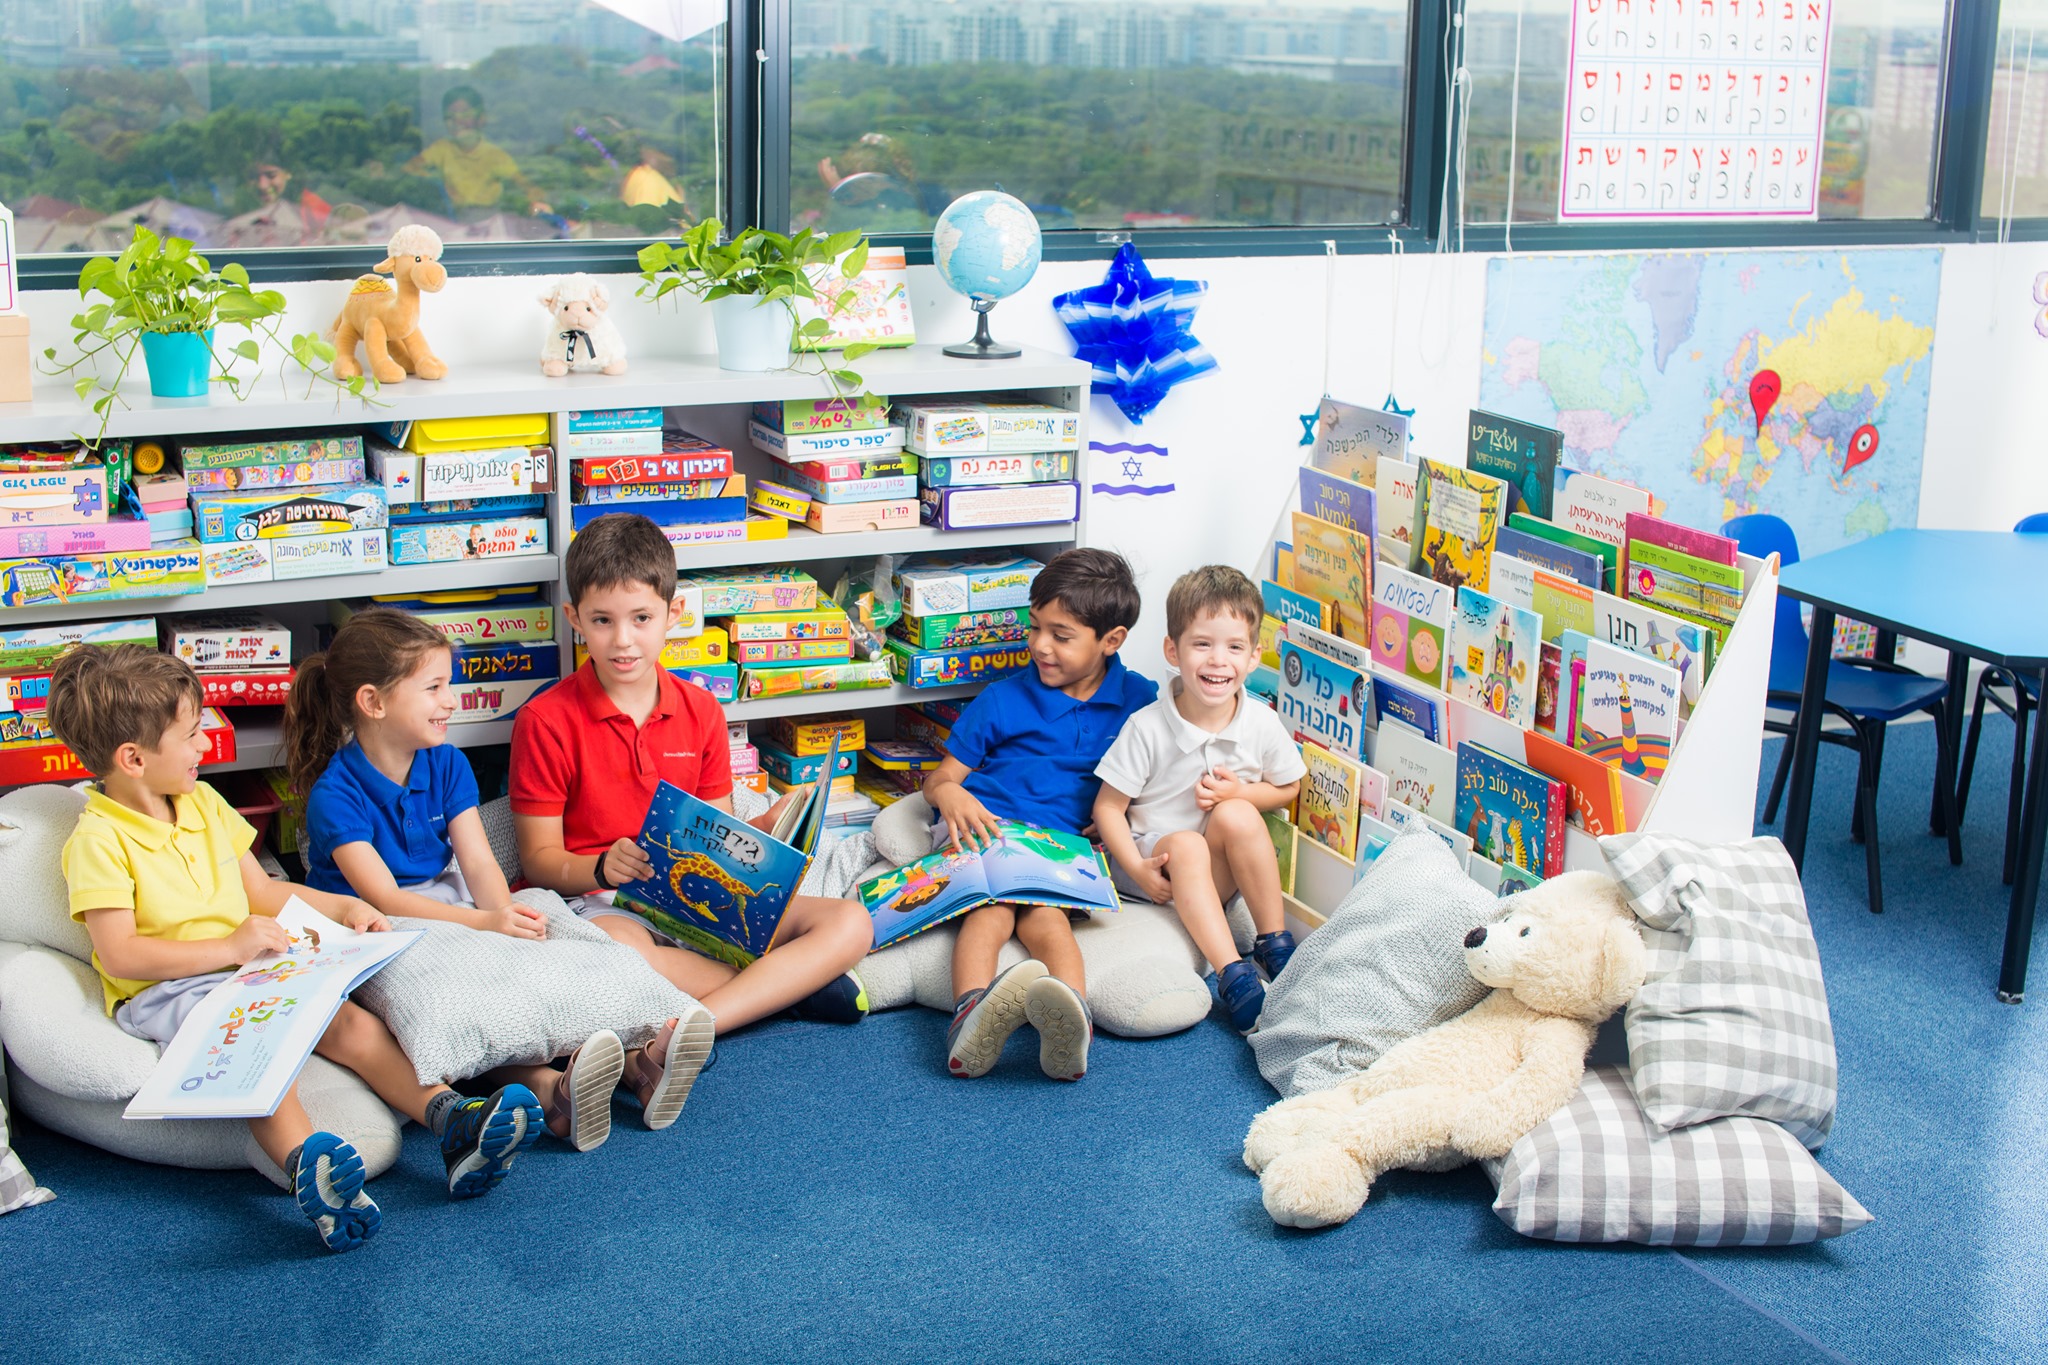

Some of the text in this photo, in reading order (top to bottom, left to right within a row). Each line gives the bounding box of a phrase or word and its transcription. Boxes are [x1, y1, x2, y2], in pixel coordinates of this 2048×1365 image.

[1730, 0, 1739, 16] ד
[1757, 0, 1764, 18] ג
[1783, 2, 1793, 20] ב
[1807, 3, 1821, 21] א
[1583, 70, 1598, 90] ס
[1643, 72, 1651, 90] נ
[1669, 73, 1683, 91] ם
[1697, 74, 1711, 92] מ
[1752, 74, 1762, 96] ך
[1778, 75, 1789, 93] כ
[1577, 146, 1807, 170] ע פ ף צ ץ ק ר ש ת
[683, 458, 726, 478] זיכרון
[30, 477, 67, 486] רצפה
[621, 483, 660, 496] מילים
[885, 479, 905, 489] מזון
[257, 512, 282, 530] לגן
[286, 504, 349, 523] אוניברסיטה
[72, 531, 95, 539] פאזל
[243, 525, 252, 538] 1
[495, 527, 518, 538] סולם
[694, 528, 742, 540] מה עושים
[477, 617, 496, 638] 2
[959, 610, 1018, 628] פטריות
[459, 651, 532, 680] בלאנקו
[750, 679, 760, 688] 24
